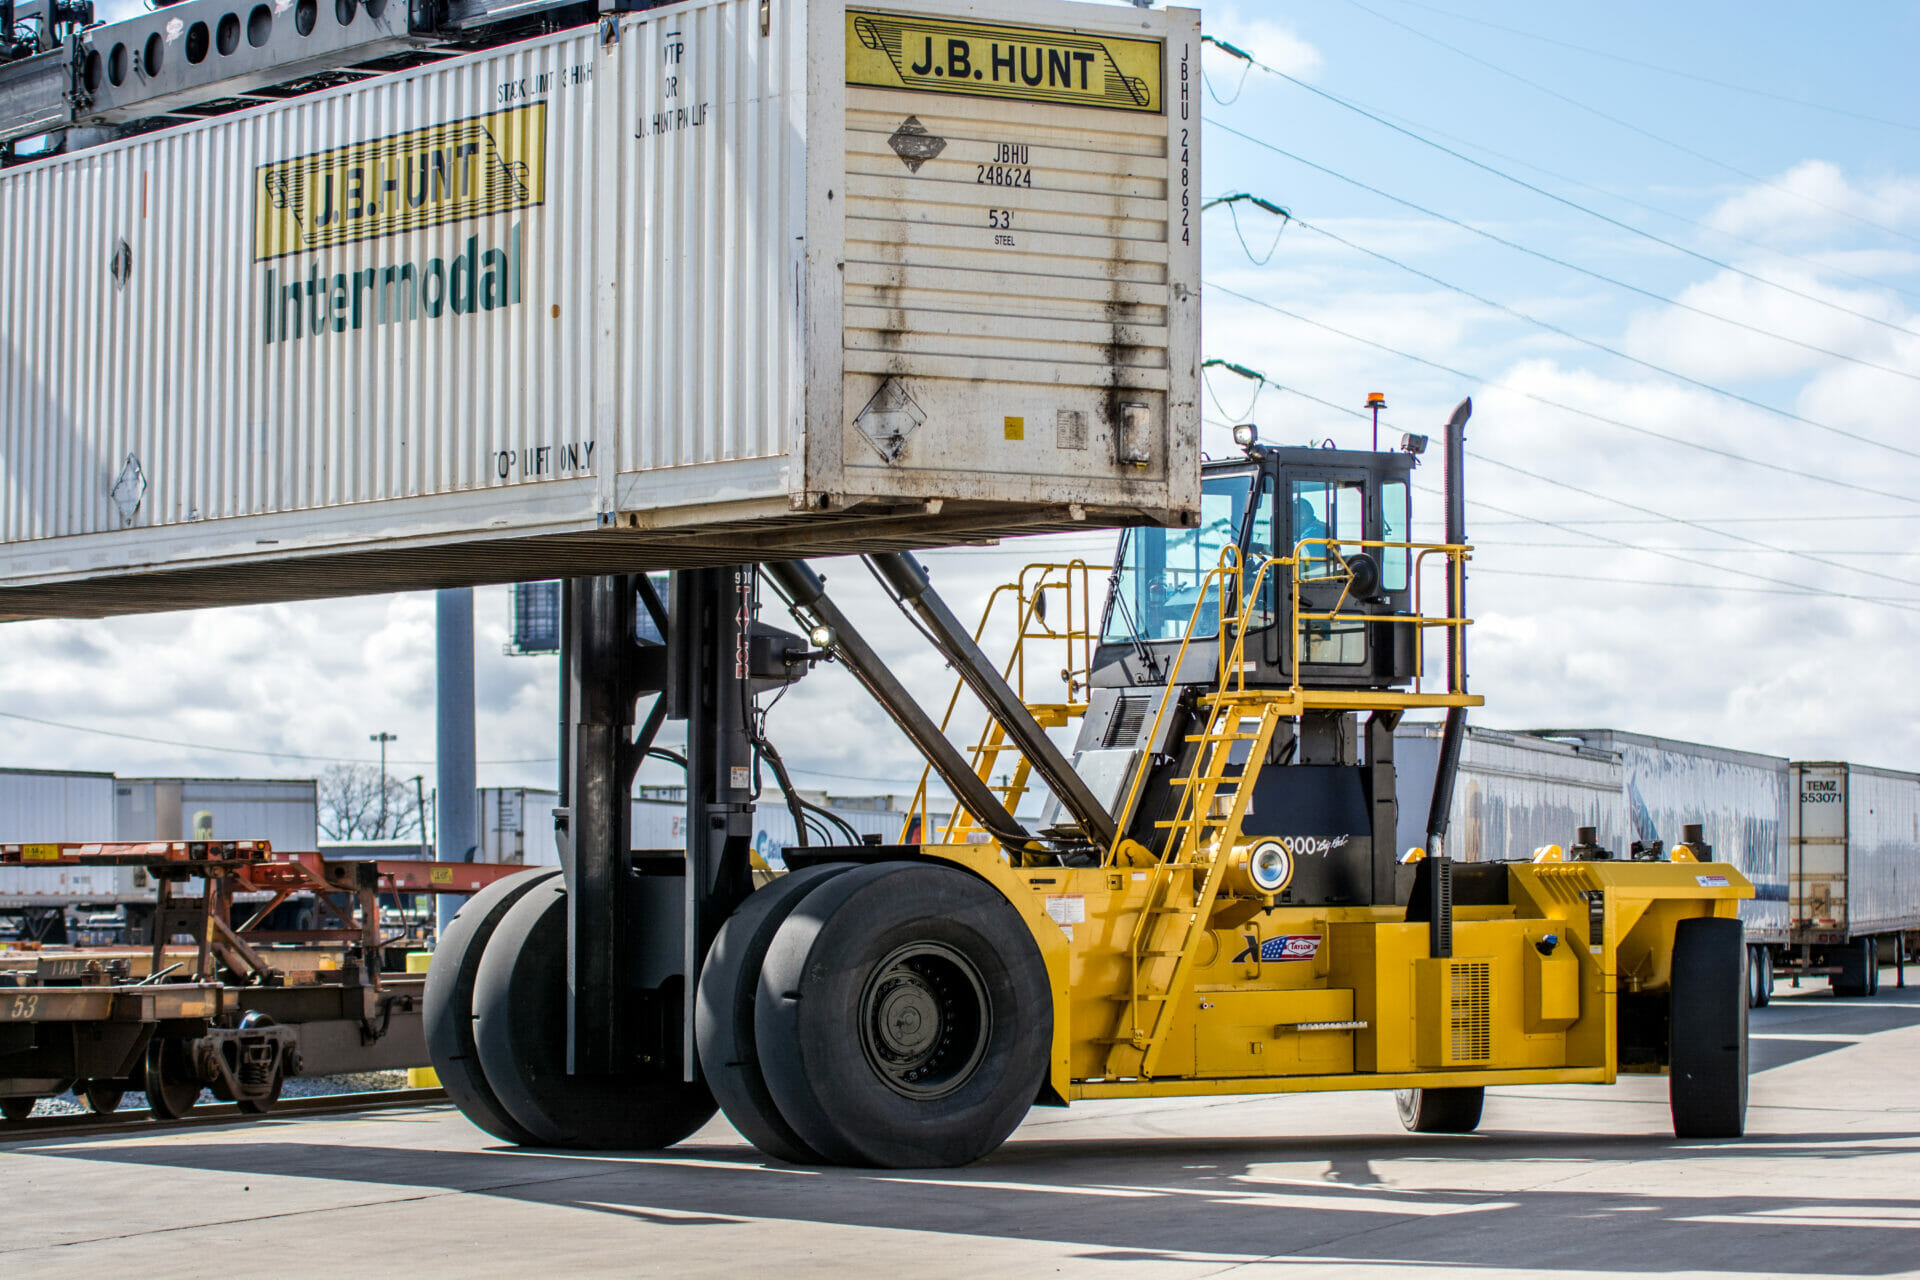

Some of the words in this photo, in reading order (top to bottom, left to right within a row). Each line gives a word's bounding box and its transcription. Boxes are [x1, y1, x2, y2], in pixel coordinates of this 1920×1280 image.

[992, 43, 1095, 90] HUNT
[1181, 43, 1189, 121] JBHU
[692, 102, 709, 126] LIF
[993, 143, 1029, 165] JBHU
[977, 164, 1031, 188] 248624
[1181, 128, 1190, 246] 248624
[994, 234, 1016, 247] STEEL
[265, 220, 521, 345] Intermodal
[493, 450, 517, 479] OP
[524, 446, 552, 476] LIFT
[1800, 792, 1843, 804] 553071
[1805, 780, 1837, 792] TEMZ
[11, 994, 40, 1019] 53
